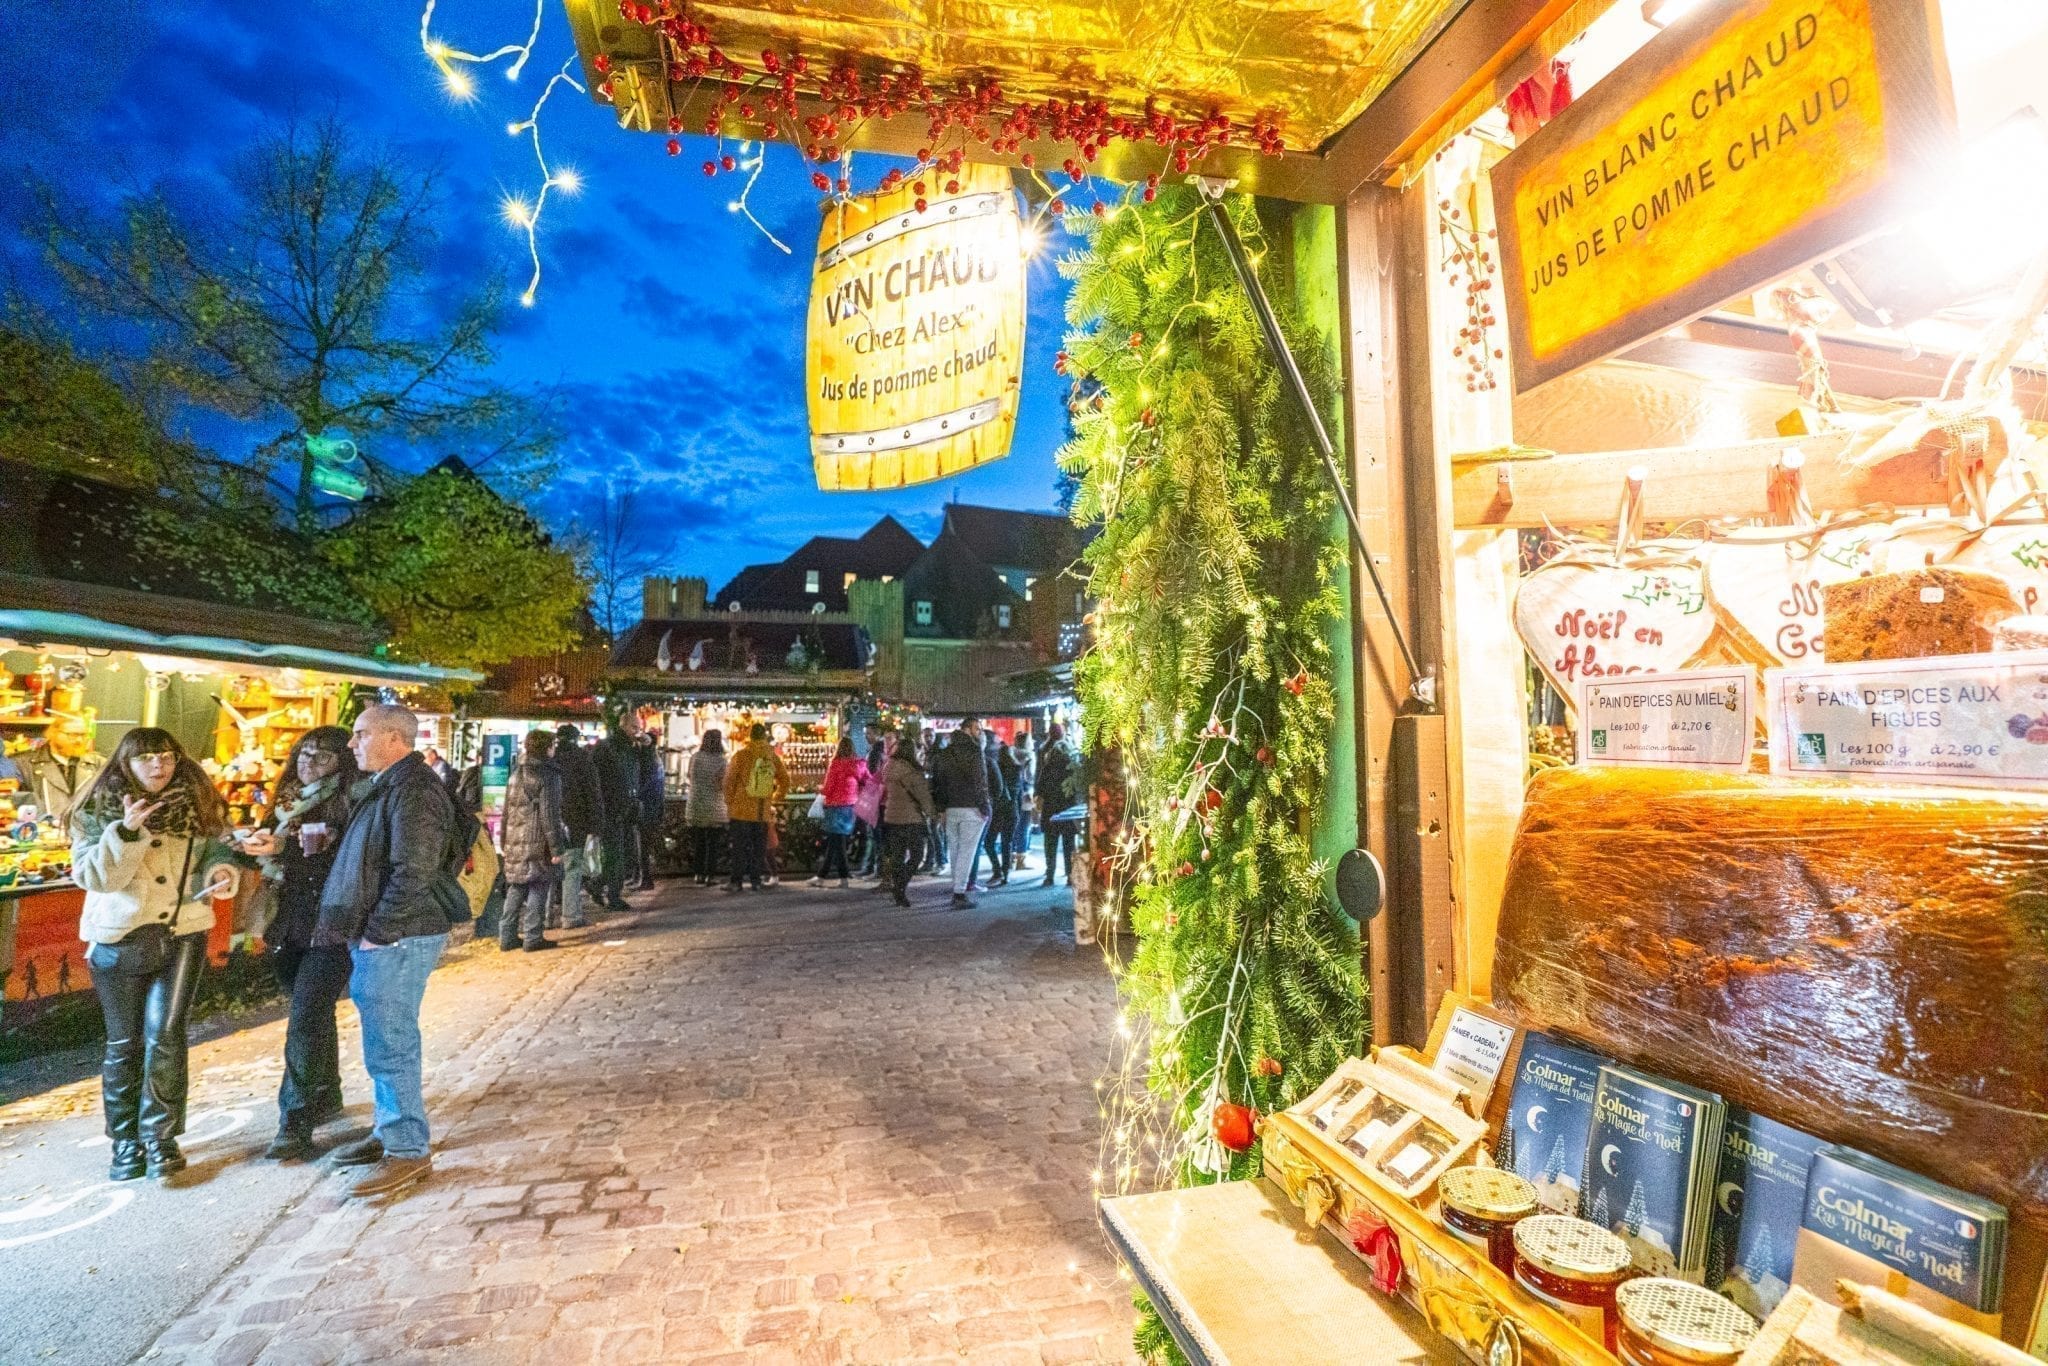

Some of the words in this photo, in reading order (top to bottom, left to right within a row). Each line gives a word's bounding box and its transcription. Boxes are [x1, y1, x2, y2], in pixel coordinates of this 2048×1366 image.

[1536, 184, 1574, 228] VIN
[1583, 112, 1678, 198] BLANC
[1691, 13, 1818, 120] CHAUD
[1531, 254, 1568, 295] JUS
[1576, 229, 1606, 266] DE
[1614, 160, 1715, 243] POMME
[1727, 77, 1851, 171] CHAUD
[826, 272, 874, 328] VIN
[884, 246, 999, 303] CHAUD
[821, 376, 844, 401] Jus
[849, 374, 867, 400] de
[873, 365, 938, 404] pomme
[943, 329, 998, 378] chaud
[1555, 609, 1627, 640] Noël
[1634, 627, 1663, 646] en
[1600, 696, 1621, 709] PAIN
[1623, 694, 1673, 708] D'EPICES
[1675, 693, 1692, 706] AU
[1695, 692, 1724, 706] MIEL
[1817, 691, 1858, 706] PAIN
[1864, 687, 1951, 706] D'EPICES
[1957, 685, 2001, 703] AUX
[1625, 722, 1640, 731] 100
[1681, 721, 1702, 732] 2,70
[1704, 721, 1712, 731] €
[1871, 711, 1942, 728] FIGUES
[488, 744, 505, 765] P
[1840, 743, 1864, 755] Les
[1867, 743, 1894, 756] 100
[1899, 746, 1911, 758] g
[1930, 743, 1945, 756] à
[1948, 744, 1983, 757] 2,90
[1987, 744, 2000, 756] €
[1850, 757, 1913, 767] Fabrication
[1451, 1025, 1471, 1039] PANIER
[1473, 1034, 1496, 1049] CADEAU
[1526, 1059, 1577, 1087] Colmar
[1598, 1091, 1650, 1126] Colmar
[1607, 1110, 1637, 1135] Magie
[1638, 1127, 1651, 1140] de
[1725, 1131, 1779, 1165] olmar
[1818, 1186, 1913, 1242] Colmar
[1841, 1215, 1894, 1251] Magie
[1894, 1241, 1918, 1264] de
